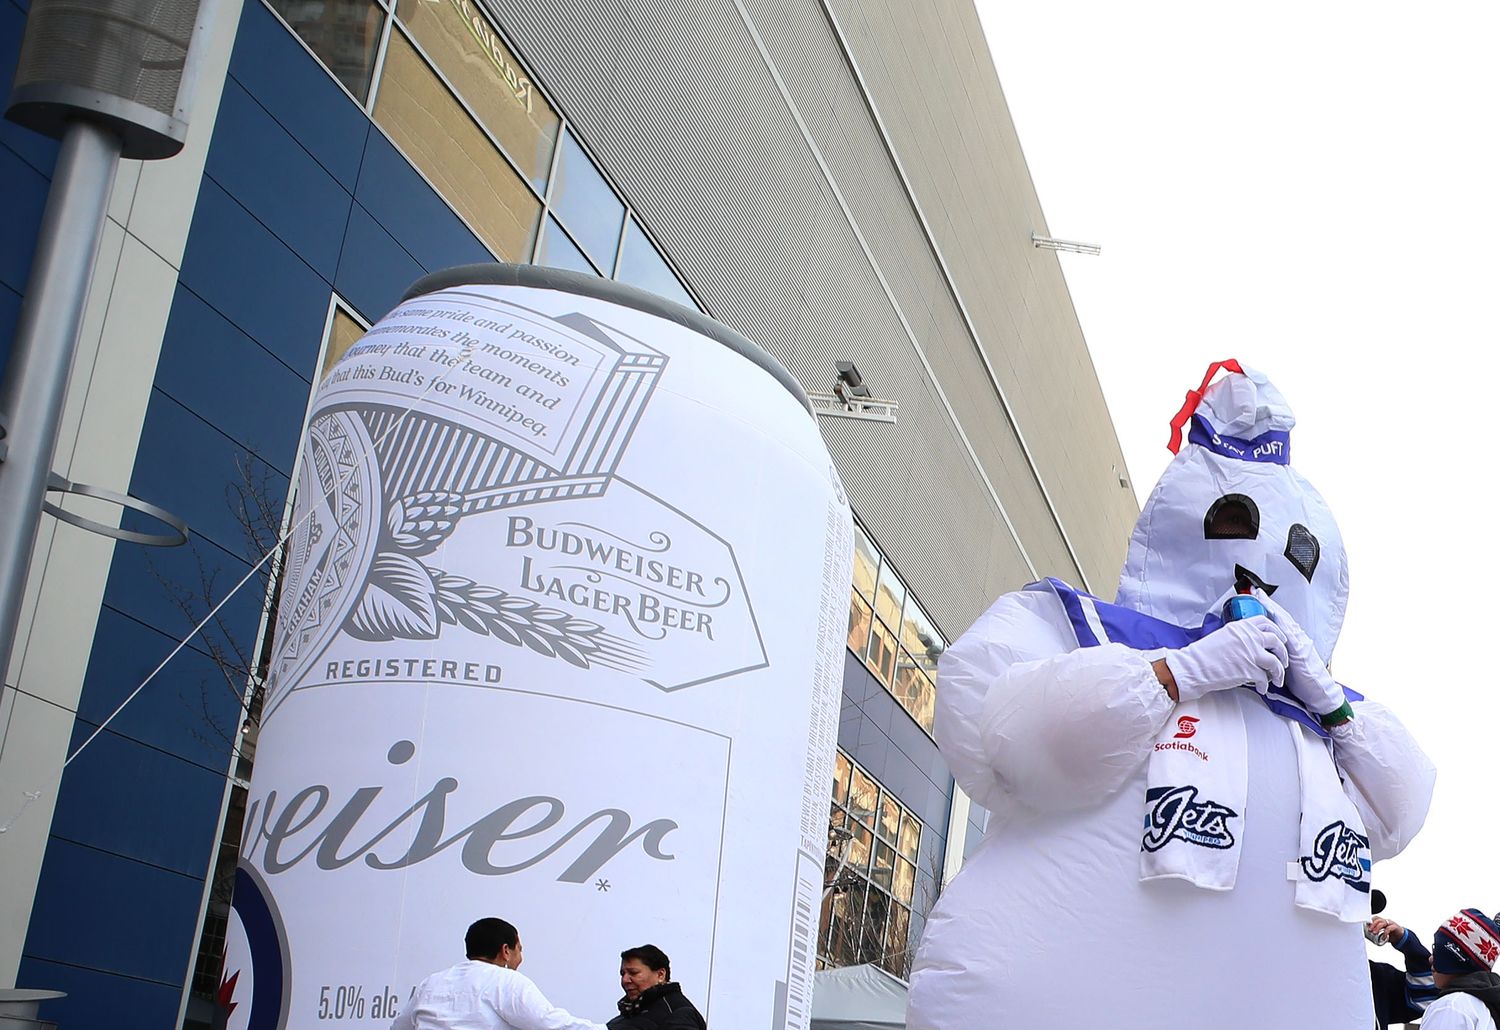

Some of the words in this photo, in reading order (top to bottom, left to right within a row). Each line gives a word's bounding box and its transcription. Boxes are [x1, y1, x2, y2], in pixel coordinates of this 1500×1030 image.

[428, 309, 474, 323] pride
[474, 317, 513, 333] and
[507, 329, 581, 367] passion
[450, 331, 480, 348] the
[481, 343, 570, 387] moments
[352, 365, 376, 380] this
[424, 375, 457, 395] for
[393, 342, 426, 358] that
[429, 349, 459, 367] the
[462, 359, 512, 388] team
[516, 383, 561, 411] and
[1253, 440, 1284, 459] PUFT
[505, 515, 707, 597] BUDWEISER
[287, 569, 322, 635] GRAHAM
[520, 555, 650, 632] LAGER
[638, 593, 715, 641] BEER
[325, 658, 503, 684] REGISTERED
[318, 985, 365, 1019] 5.0%
